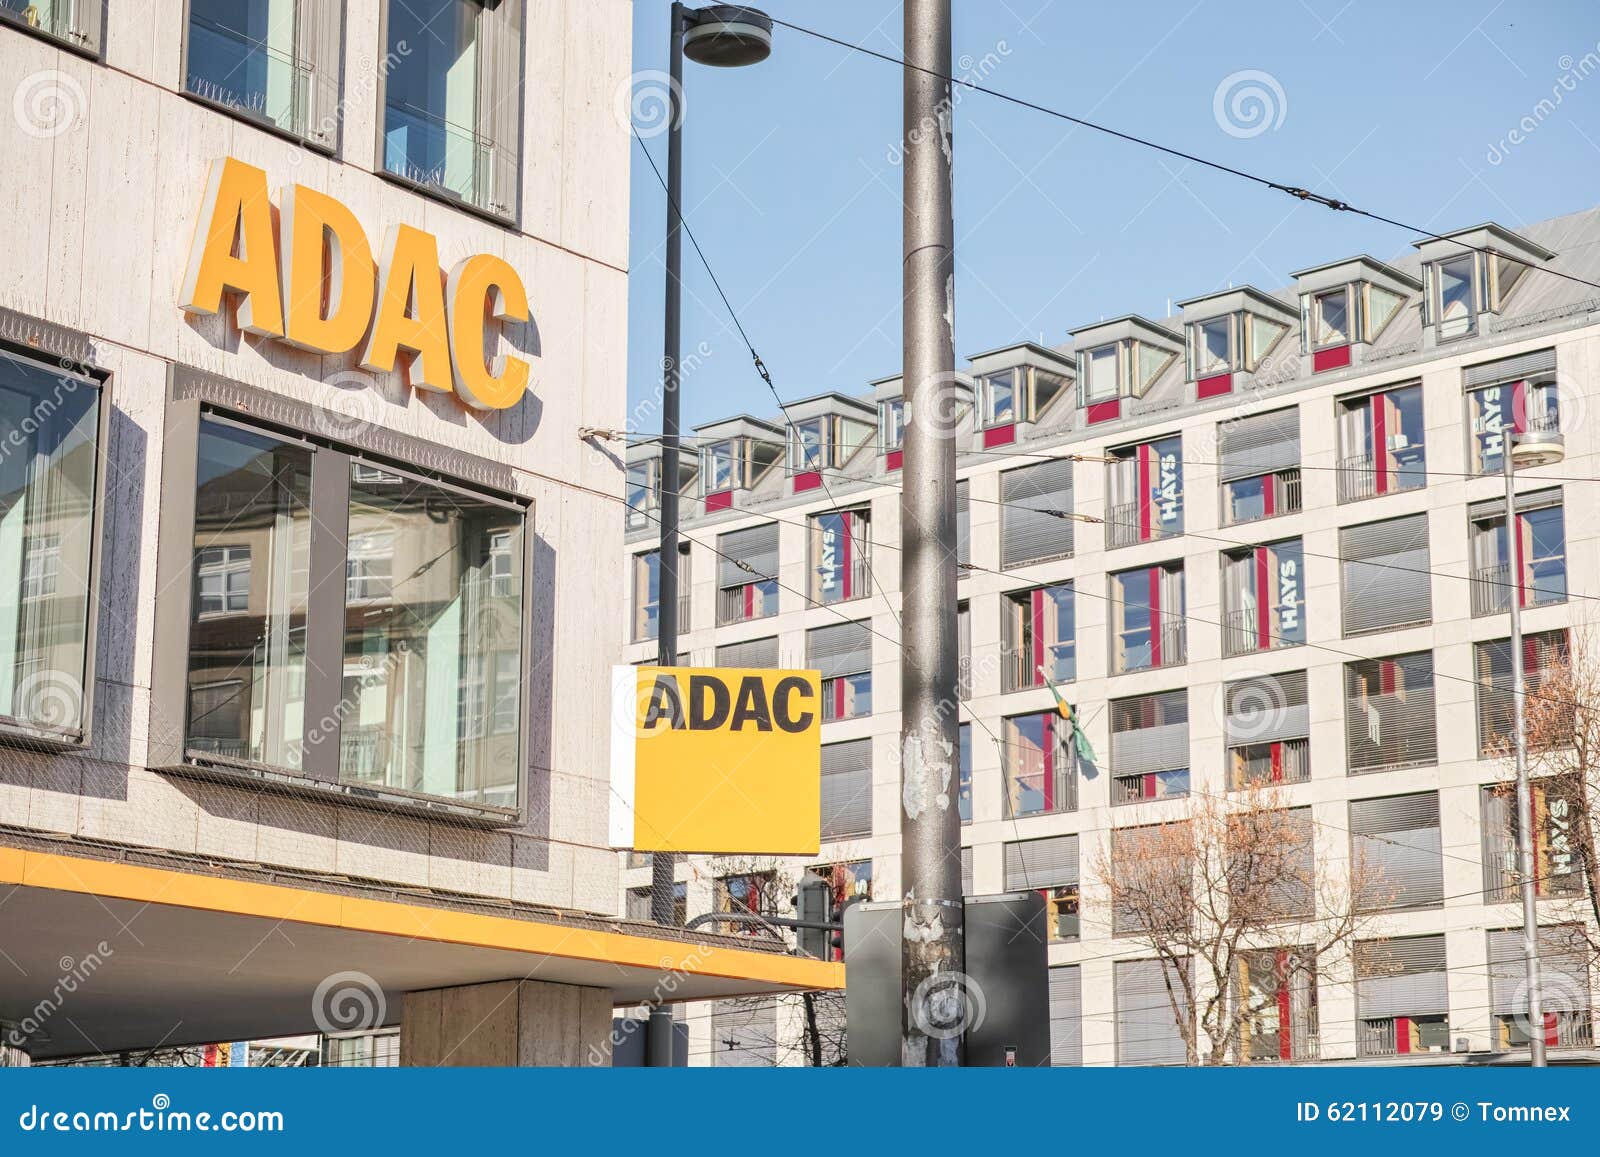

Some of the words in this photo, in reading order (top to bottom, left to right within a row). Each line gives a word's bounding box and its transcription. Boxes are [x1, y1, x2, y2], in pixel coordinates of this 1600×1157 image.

[178, 156, 530, 411] ADAC
[1483, 386, 1504, 456] HAYS
[1161, 454, 1177, 520] HAYS
[822, 527, 835, 592] HAYS
[1281, 559, 1298, 629] HAYS
[643, 674, 814, 733] ADAC
[1550, 799, 1571, 874] HAYS
